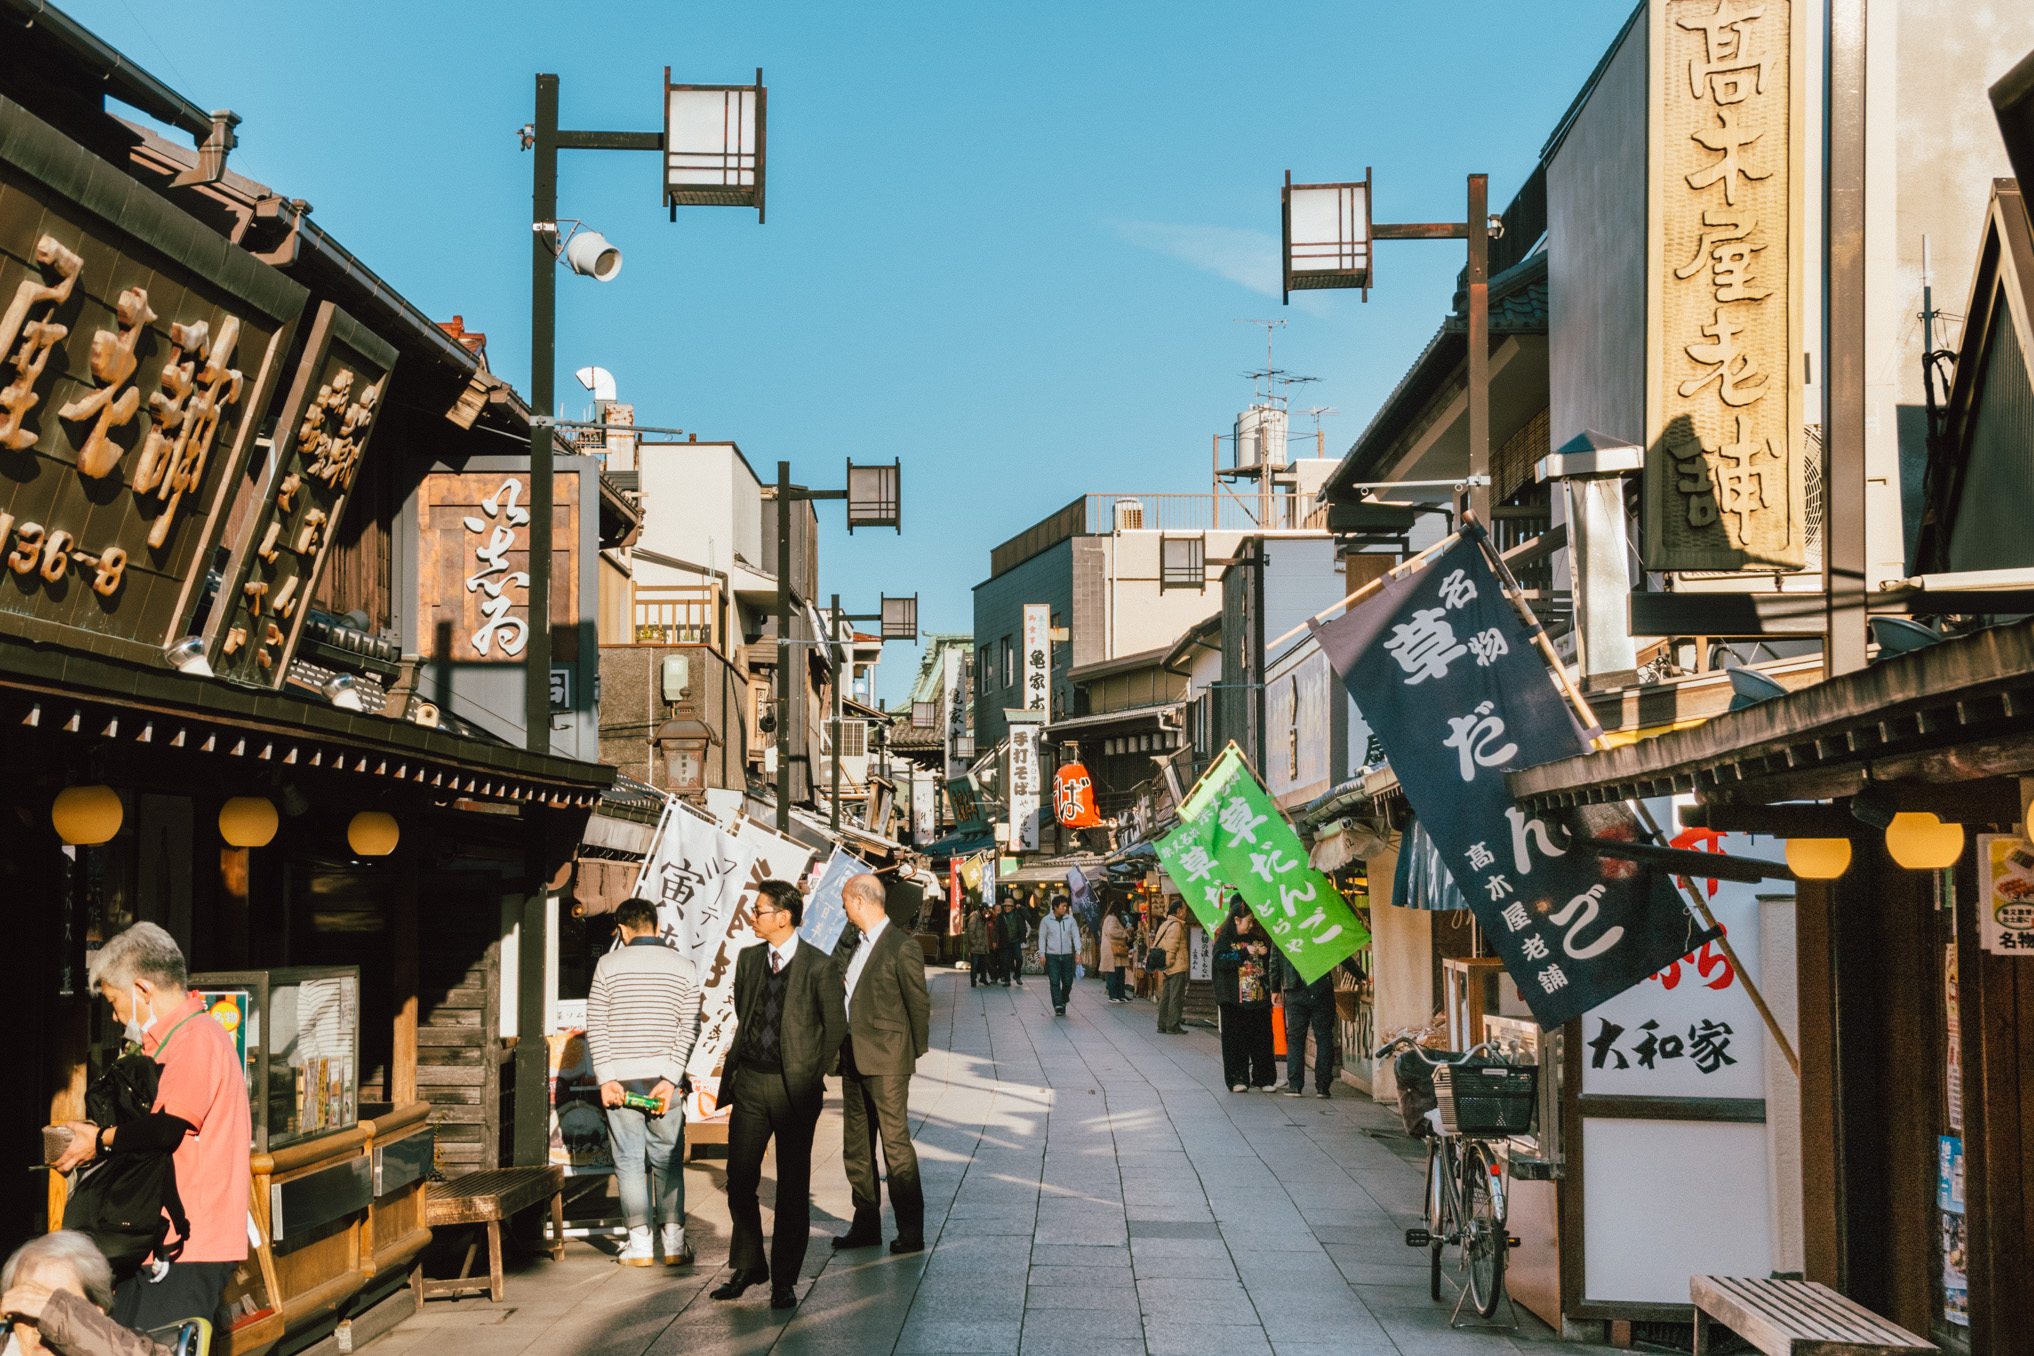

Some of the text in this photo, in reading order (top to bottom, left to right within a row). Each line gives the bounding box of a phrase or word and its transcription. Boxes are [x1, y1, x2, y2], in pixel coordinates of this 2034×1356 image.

[1439, 569, 1508, 666] 名物
[1029, 649, 1046, 726] 亀家本
[1013, 731, 1029, 796] 手打そば
[1383, 607, 1625, 960] 草だんご
[1219, 797, 1342, 944] 草だんご
[1257, 900, 1304, 952] とらや
[213, 1010, 239, 1024] 名物
[1587, 1016, 1739, 1075] 大和家
